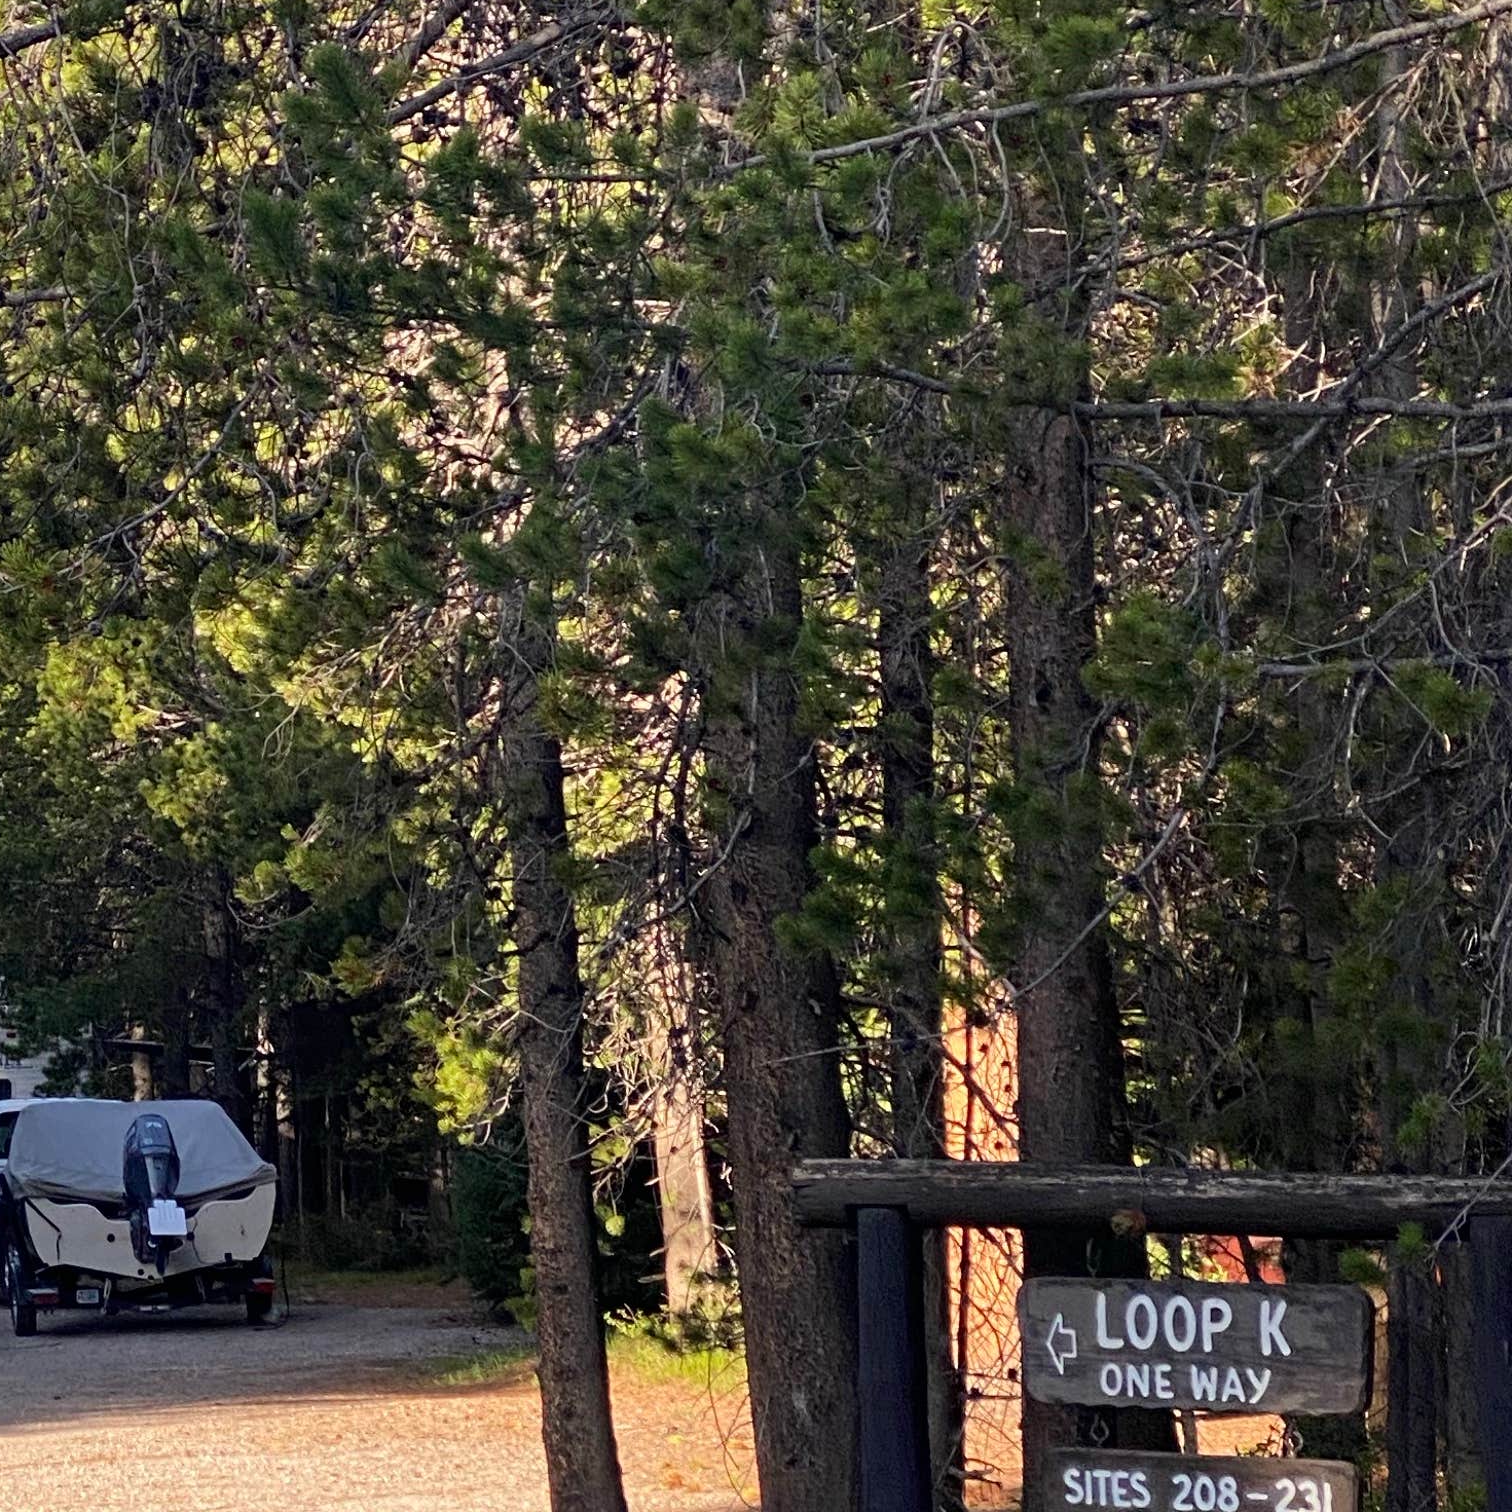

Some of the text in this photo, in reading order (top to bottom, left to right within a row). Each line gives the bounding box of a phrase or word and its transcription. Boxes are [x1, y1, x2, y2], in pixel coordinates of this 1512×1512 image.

[1096, 1291, 1292, 1356] LOOP K
[1100, 1362, 1272, 1405] ONE WAY
[1063, 1467, 1152, 1509] SITES
